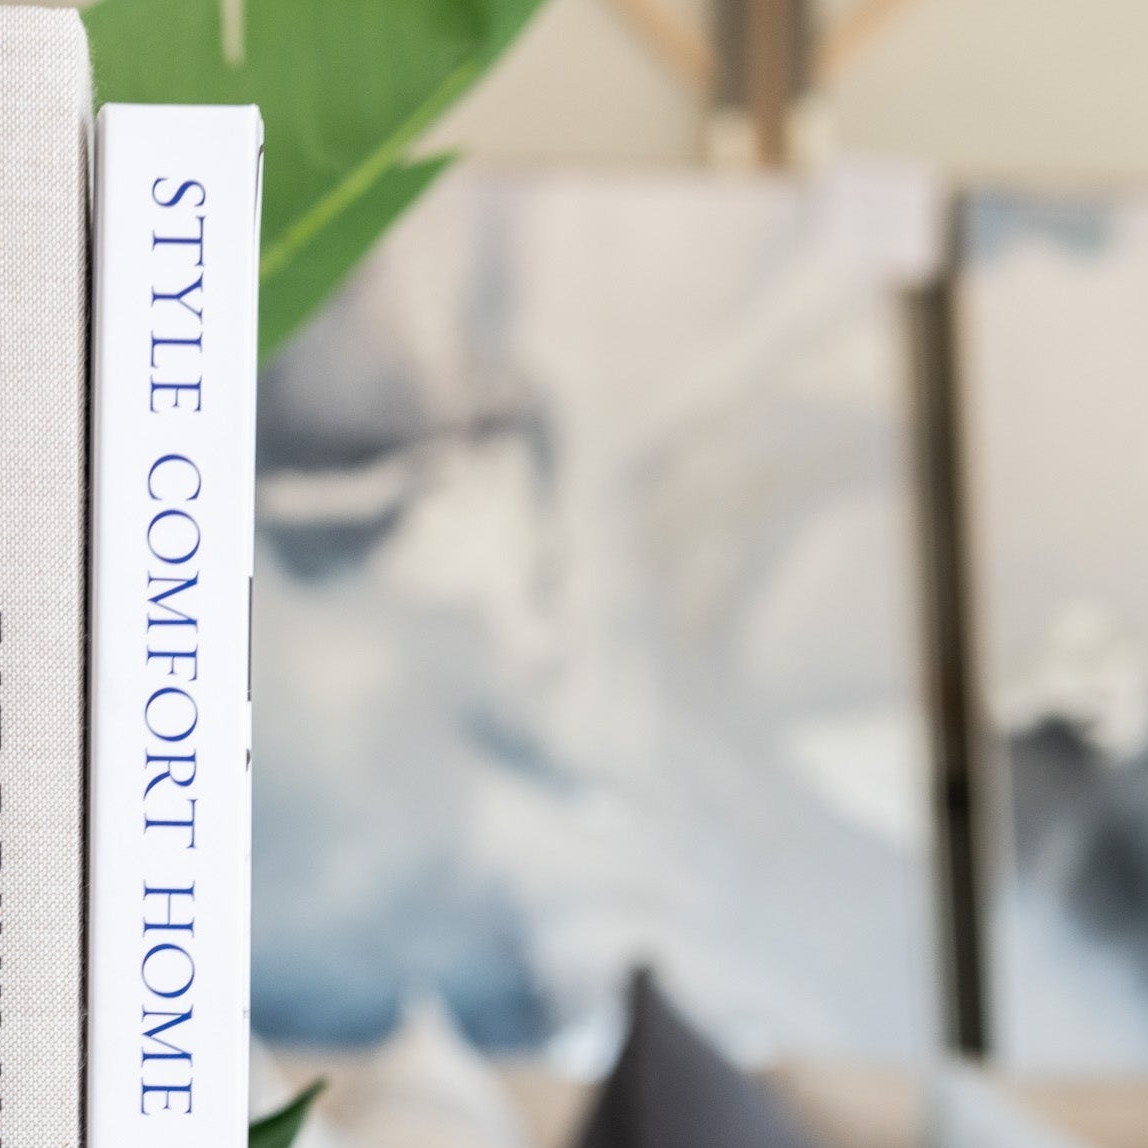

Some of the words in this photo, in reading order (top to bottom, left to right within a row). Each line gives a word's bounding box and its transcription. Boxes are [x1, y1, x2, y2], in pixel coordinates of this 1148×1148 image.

[149, 176, 206, 414] STYLE
[143, 453, 202, 850] COMFORT
[140, 879, 195, 1116] HOME
